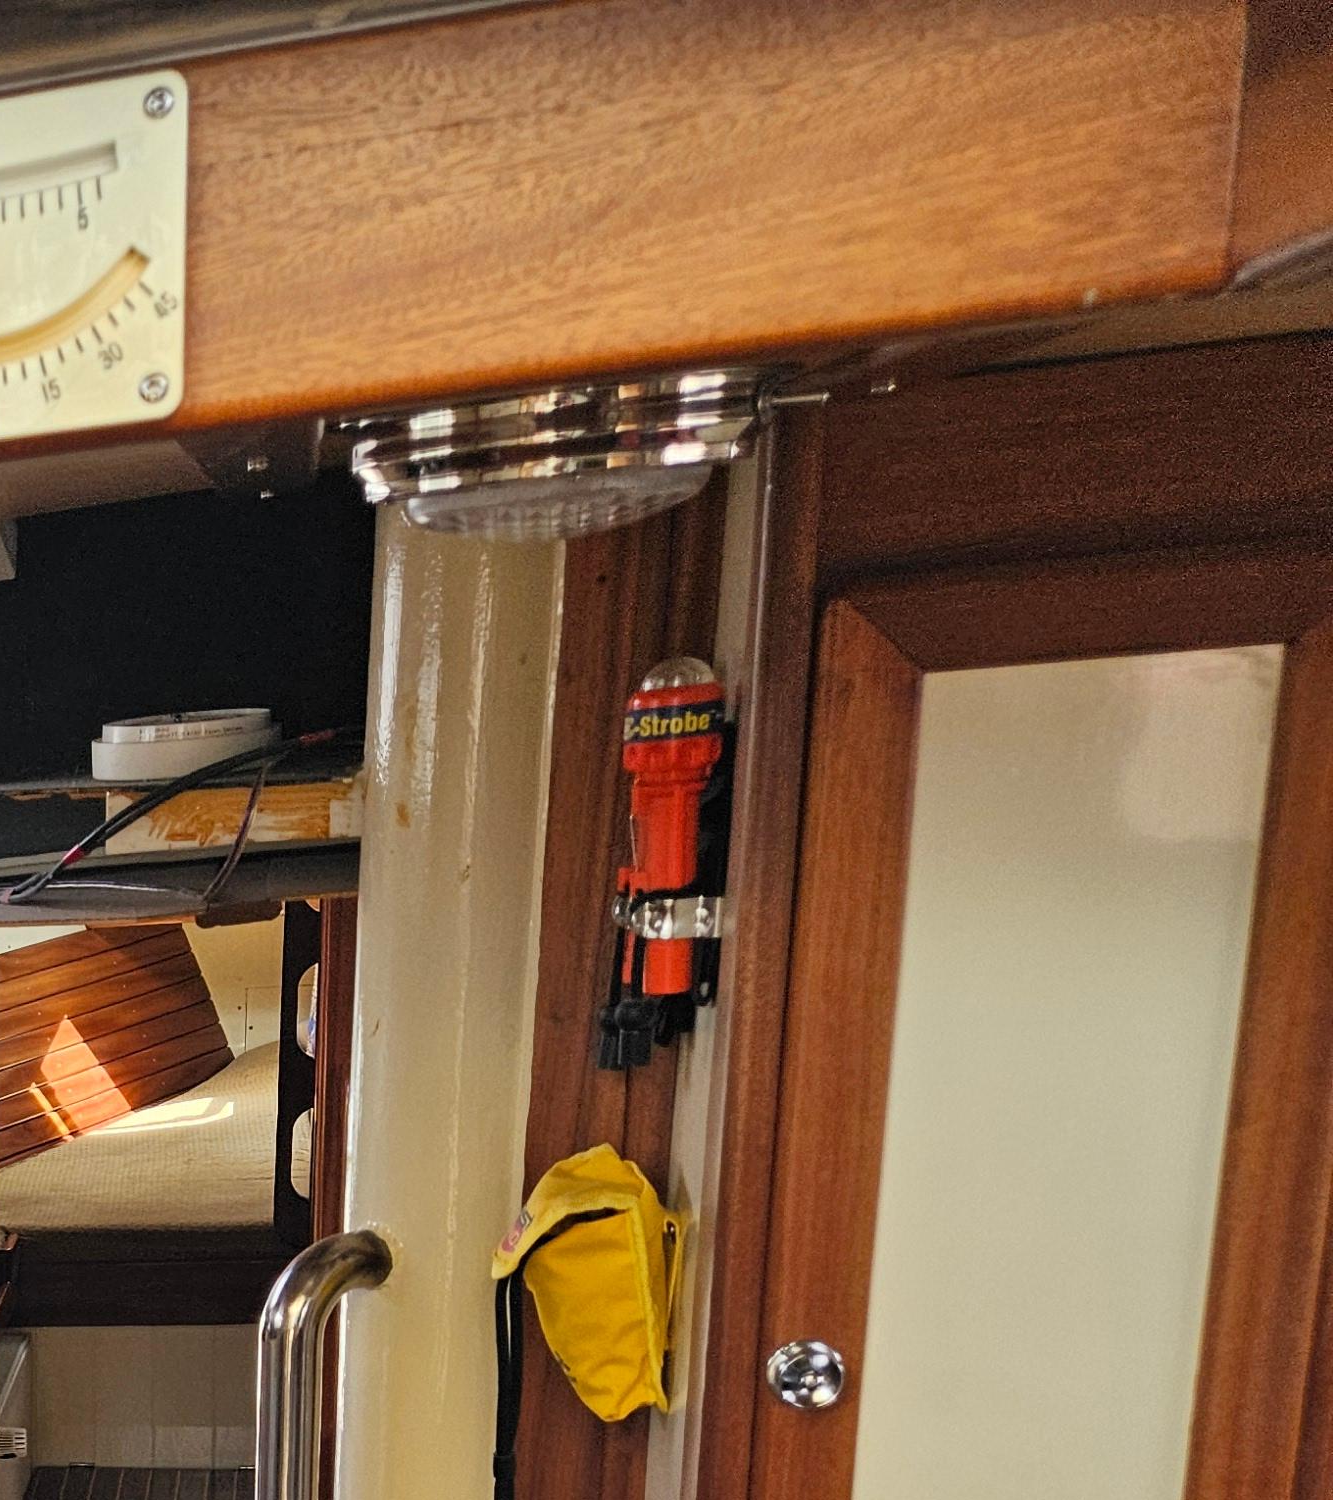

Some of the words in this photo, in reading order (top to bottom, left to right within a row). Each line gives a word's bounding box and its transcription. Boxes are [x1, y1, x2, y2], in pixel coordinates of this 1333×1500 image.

[77, 206, 89, 231] 5
[41, 381, 62, 401] 15
[97, 342, 124, 370] 30
[153, 290, 178, 319] 45
